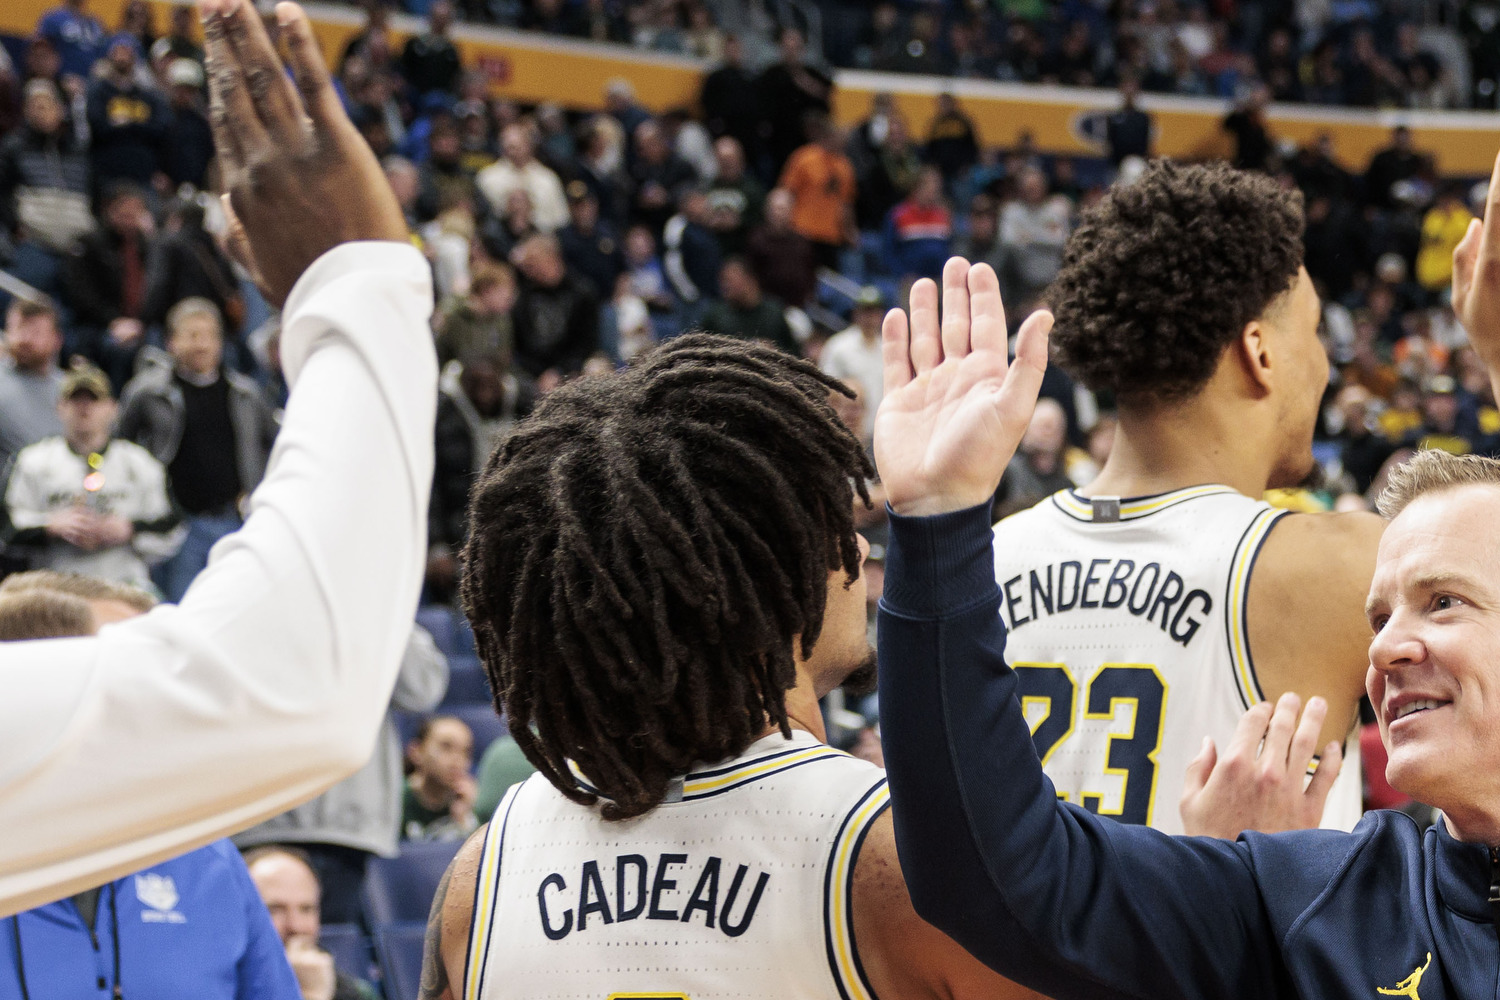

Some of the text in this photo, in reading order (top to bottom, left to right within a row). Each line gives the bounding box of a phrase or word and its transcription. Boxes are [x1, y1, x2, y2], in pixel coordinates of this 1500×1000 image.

[1003, 558, 1213, 648] ENDEBORG
[1010, 661, 1170, 827] 23
[537, 853, 770, 941] CADEAU
